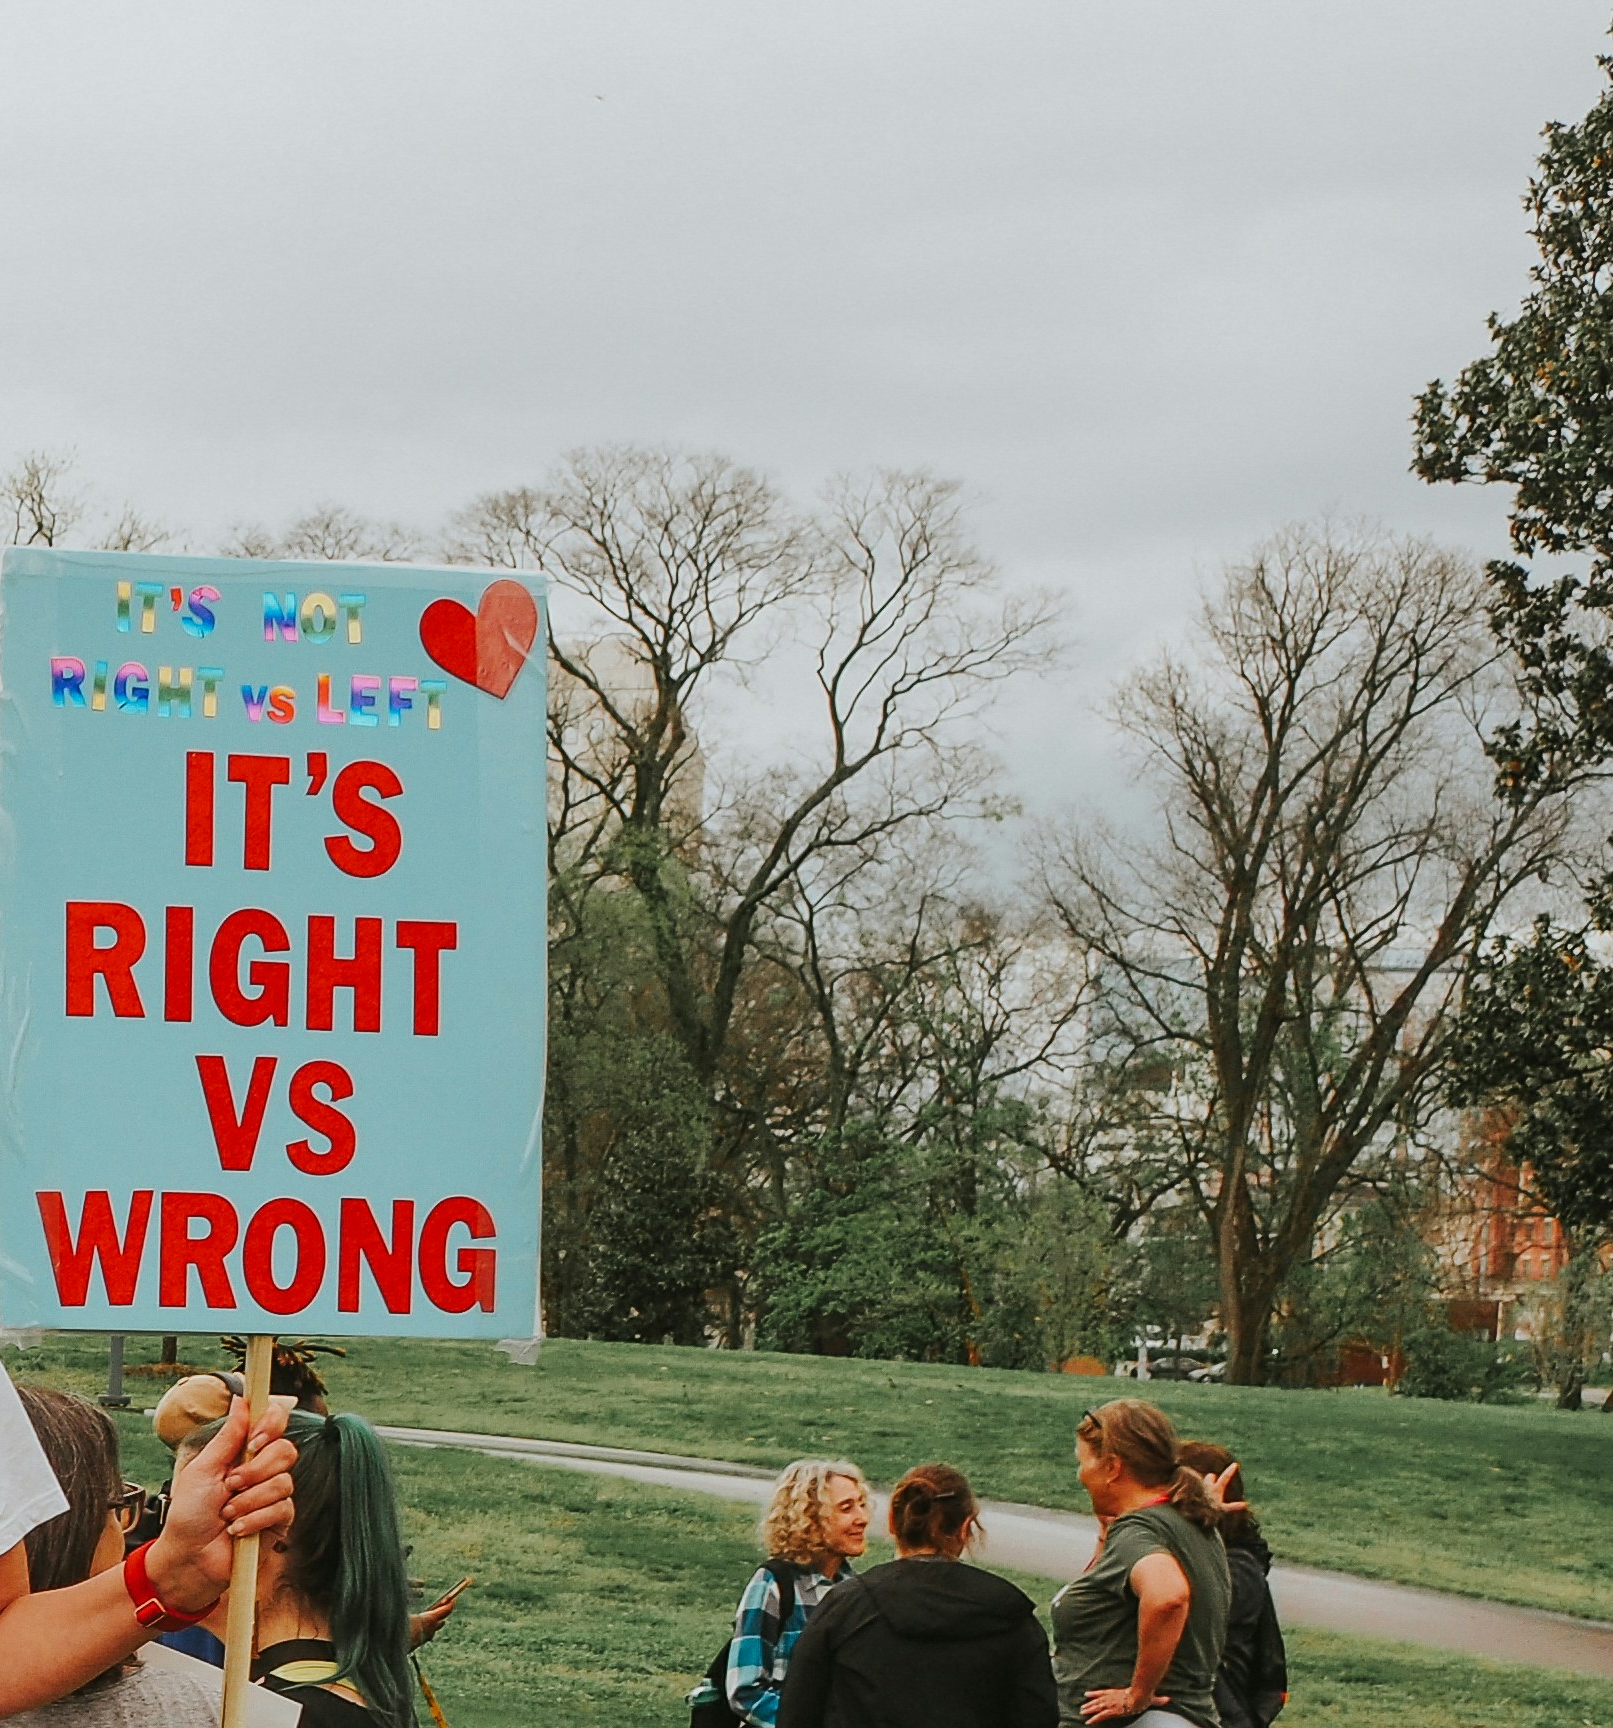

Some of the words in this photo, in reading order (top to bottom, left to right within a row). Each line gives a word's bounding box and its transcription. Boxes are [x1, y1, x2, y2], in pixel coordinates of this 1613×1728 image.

[115, 580, 221, 638] IT'S
[263, 591, 366, 645] NOT
[50, 655, 224, 719] RIGHT
[316, 673, 447, 730] LEFT
[184, 751, 403, 879] IT'S
[64, 901, 457, 1037] RIGHT
[195, 1055, 356, 1176] VS
[36, 1190, 497, 1315] WRONG
